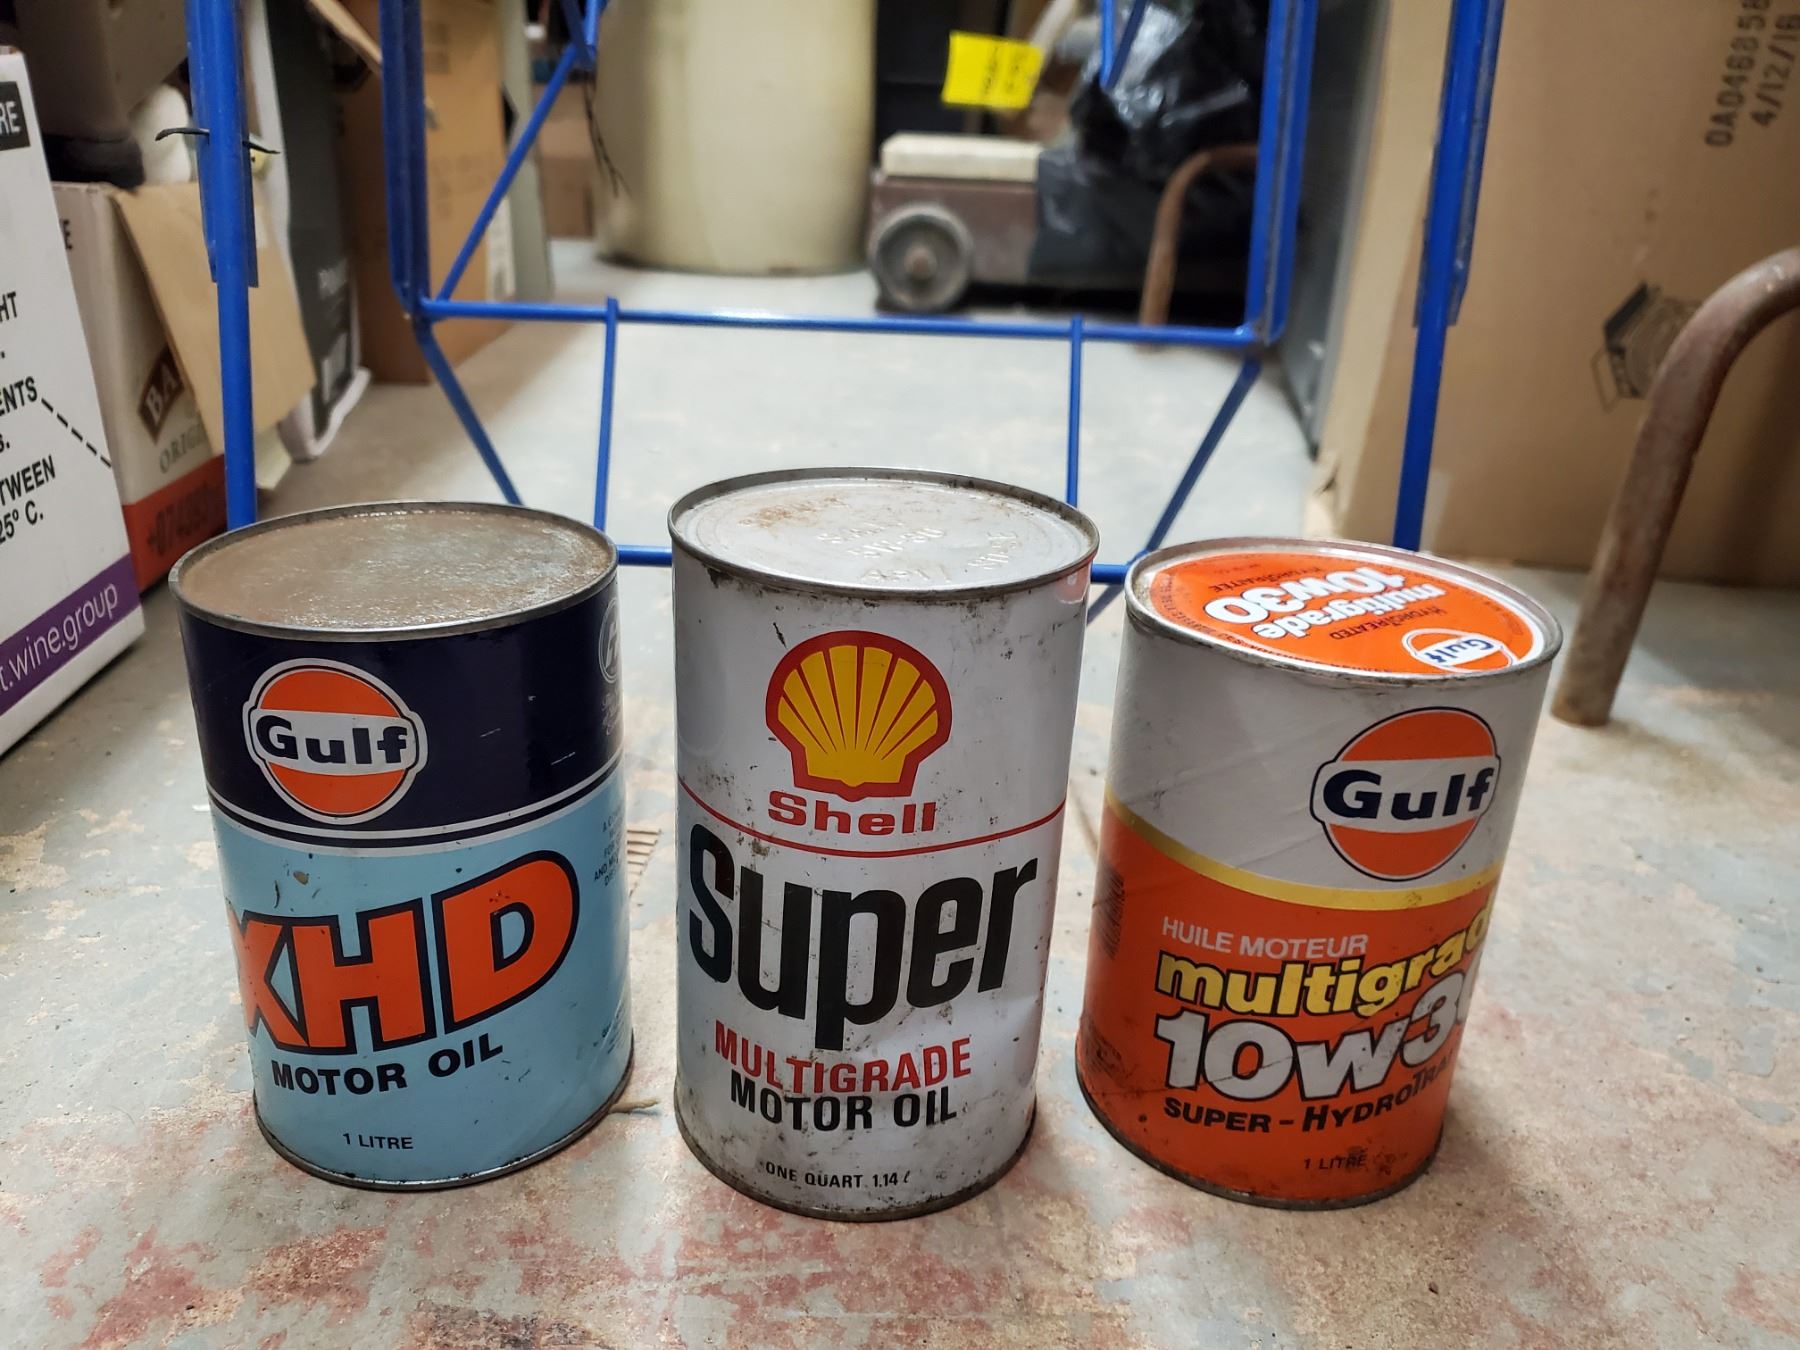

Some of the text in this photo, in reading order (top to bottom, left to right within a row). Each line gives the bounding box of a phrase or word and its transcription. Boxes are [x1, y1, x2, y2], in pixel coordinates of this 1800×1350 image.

[1424, 638, 1494, 663] Gulf
[255, 715, 409, 764] Gulf
[768, 790, 937, 836] Shell
[1323, 767, 1495, 820] Gulf
[689, 823, 1038, 1051] Super
[1162, 916, 1369, 960] HUILE MOTEUR
[271, 1032, 504, 1096] MOTOR OIL
[715, 1019, 972, 1094] MULTIGRADE
[730, 1069, 958, 1131] MOTOR OIL
[342, 1132, 414, 1151] 1 LITRE
[1303, 1153, 1368, 1170] 1 LITRE
[765, 1161, 798, 1182] ONE
[805, 1172, 863, 1189] QUART
[873, 1173, 899, 1188] 1.14
